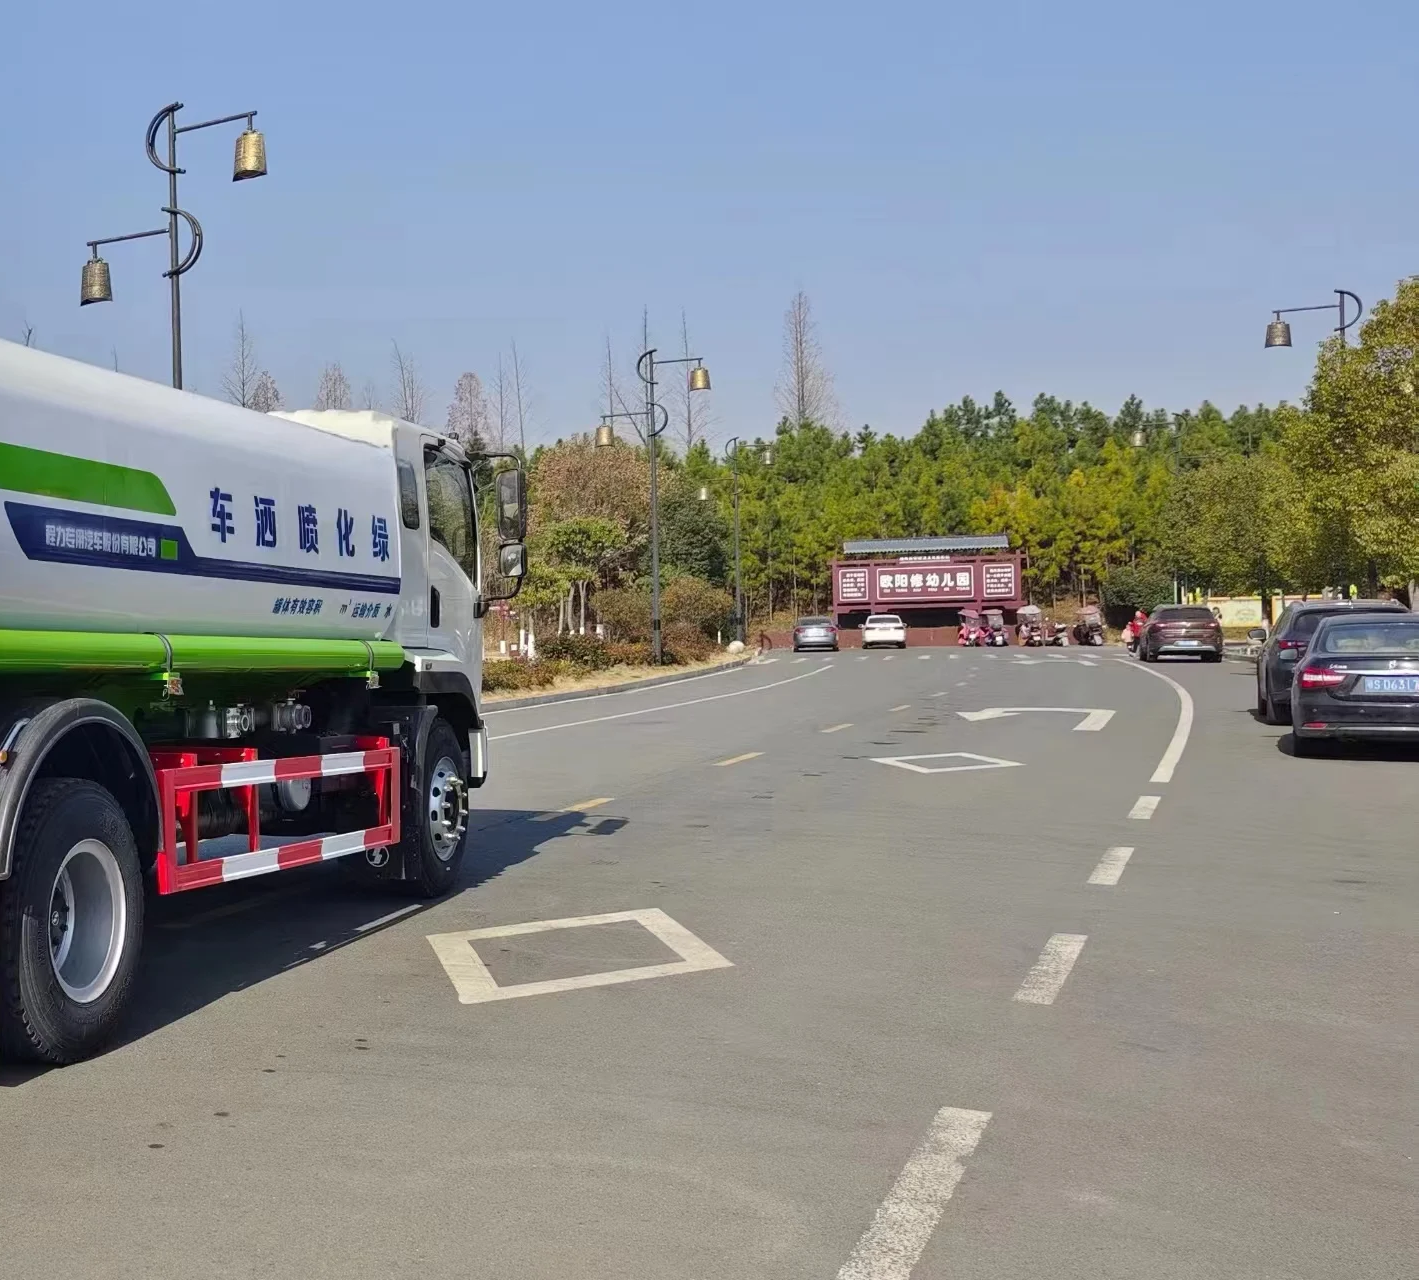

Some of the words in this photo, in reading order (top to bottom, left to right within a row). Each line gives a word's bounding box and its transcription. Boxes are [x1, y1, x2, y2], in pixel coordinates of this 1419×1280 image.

[879, 572, 970, 588] 欧阳修幼儿园
